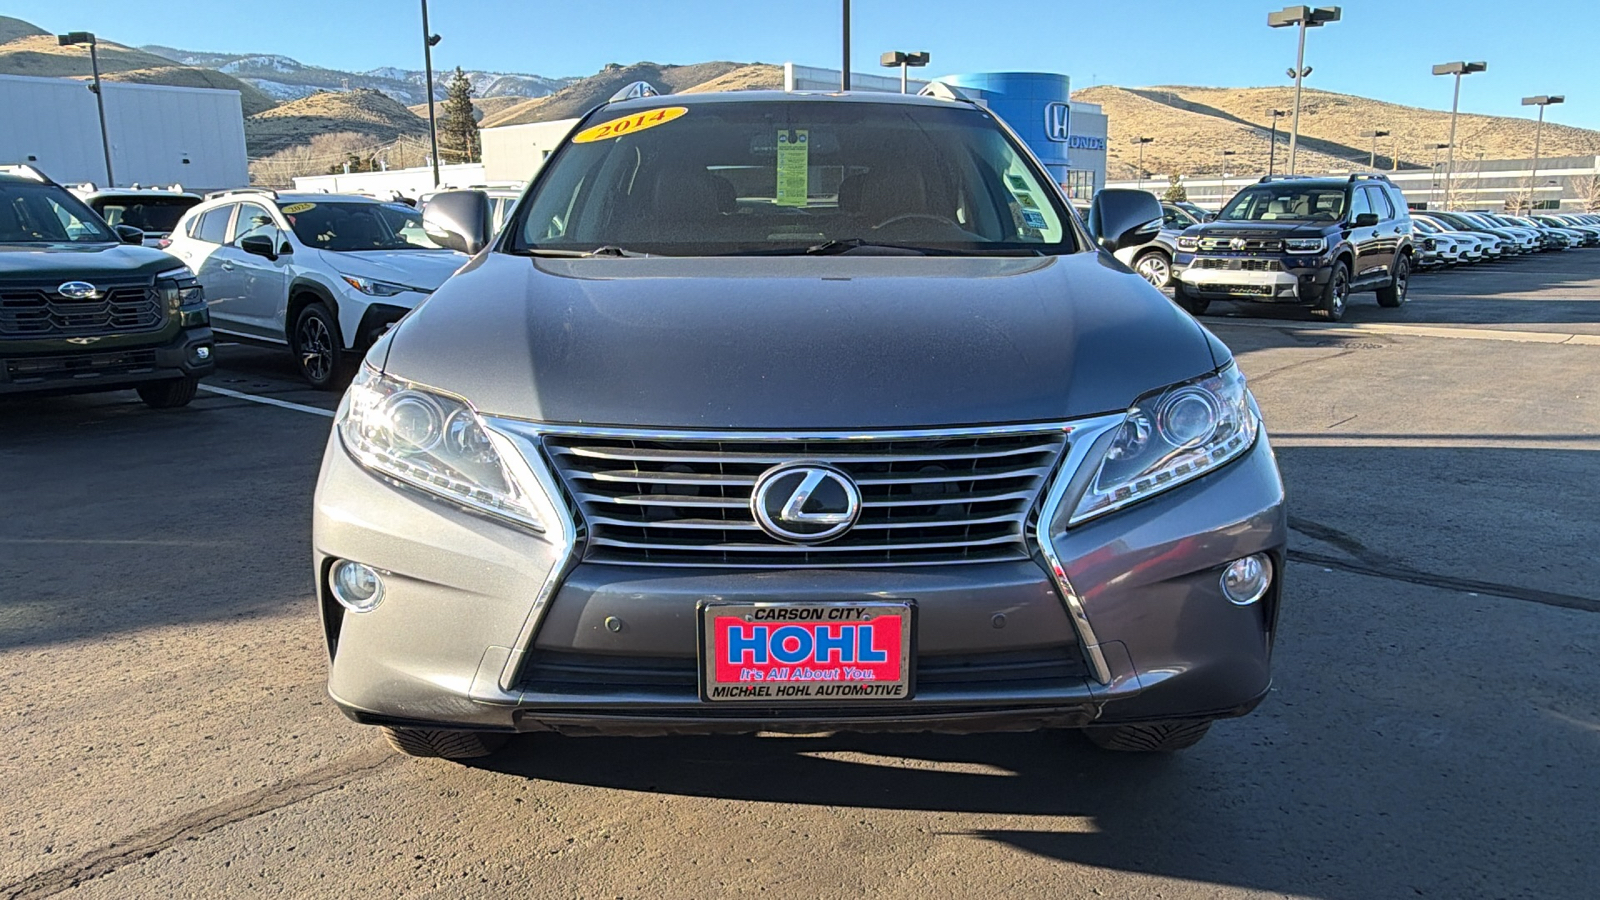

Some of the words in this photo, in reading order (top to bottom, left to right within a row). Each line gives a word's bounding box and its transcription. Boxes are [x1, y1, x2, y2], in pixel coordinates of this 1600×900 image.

[595, 109, 667, 139] 2014
[1068, 135, 1106, 150] ONDA
[754, 607, 825, 621] CARSON
[828, 607, 867, 620] CITY
[728, 625, 888, 664] HOHL
[740, 668, 763, 680] It's
[767, 668, 788, 680] All
[791, 667, 840, 680] About
[842, 666, 876, 680] You.
[712, 685, 772, 698] MICHAEL
[776, 685, 812, 697] HOHL
[815, 684, 903, 697] AUTOMOTIVE
